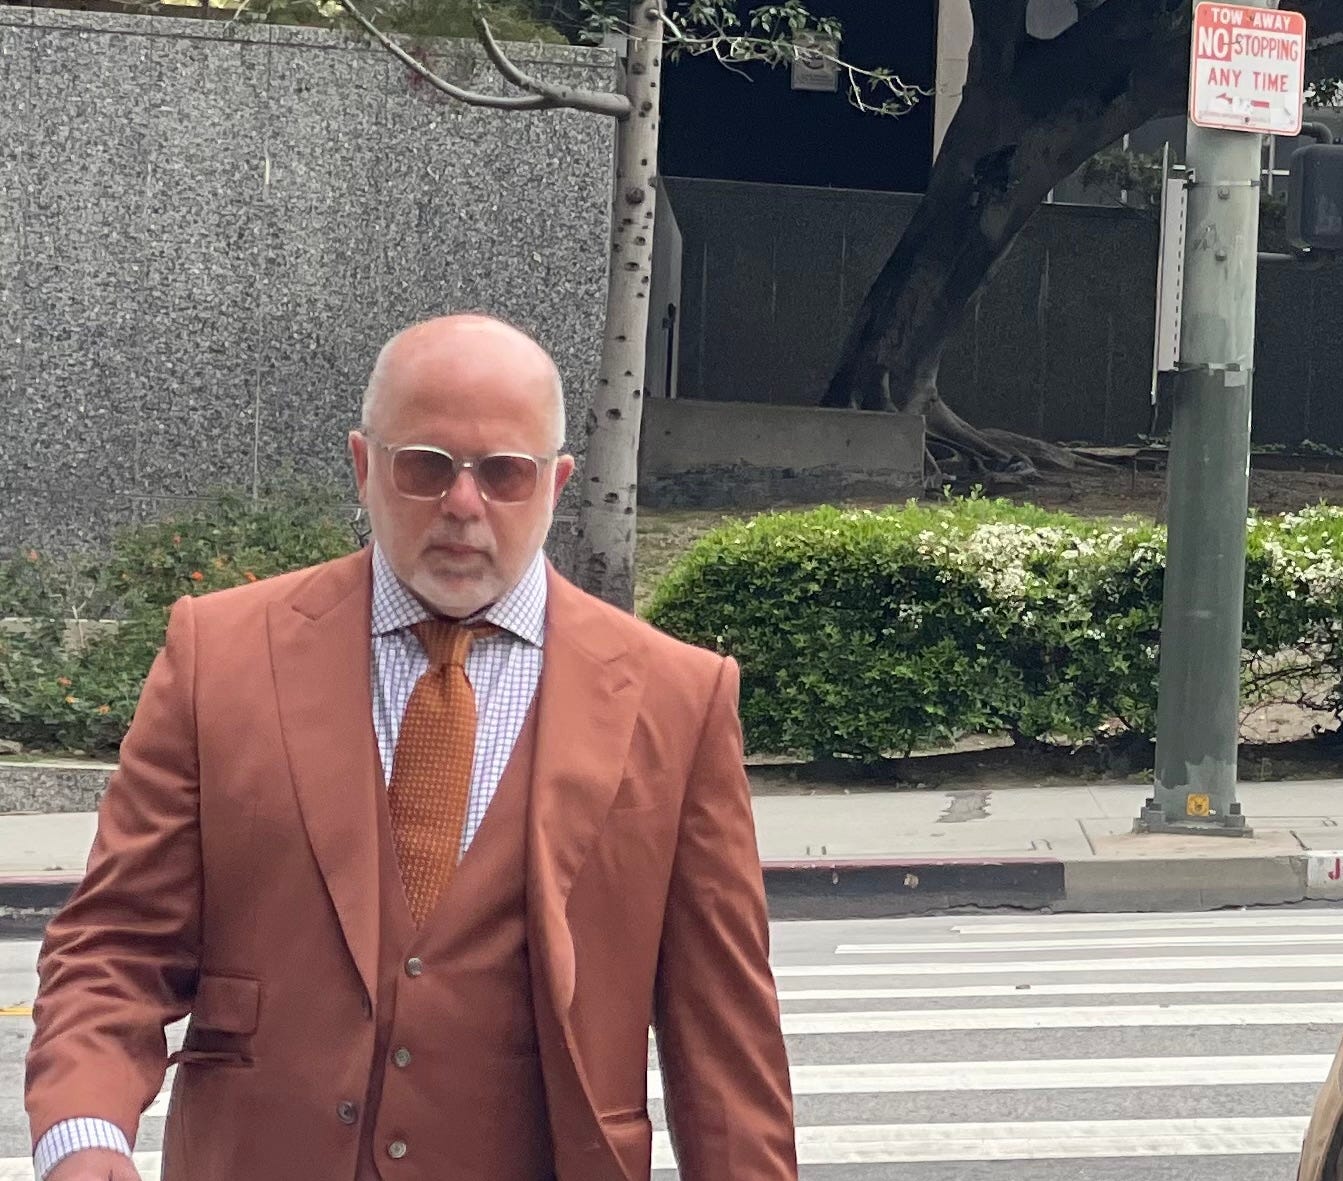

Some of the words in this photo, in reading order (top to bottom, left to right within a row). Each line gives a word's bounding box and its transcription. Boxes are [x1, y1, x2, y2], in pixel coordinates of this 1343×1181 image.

[1211, 7, 1243, 26] TOW
[1253, 11, 1291, 31] AWAY
[1198, 26, 1230, 59] NO
[1234, 33, 1298, 62] STOPPING
[1207, 67, 1242, 88] ANY
[1253, 71, 1289, 93] TIME
